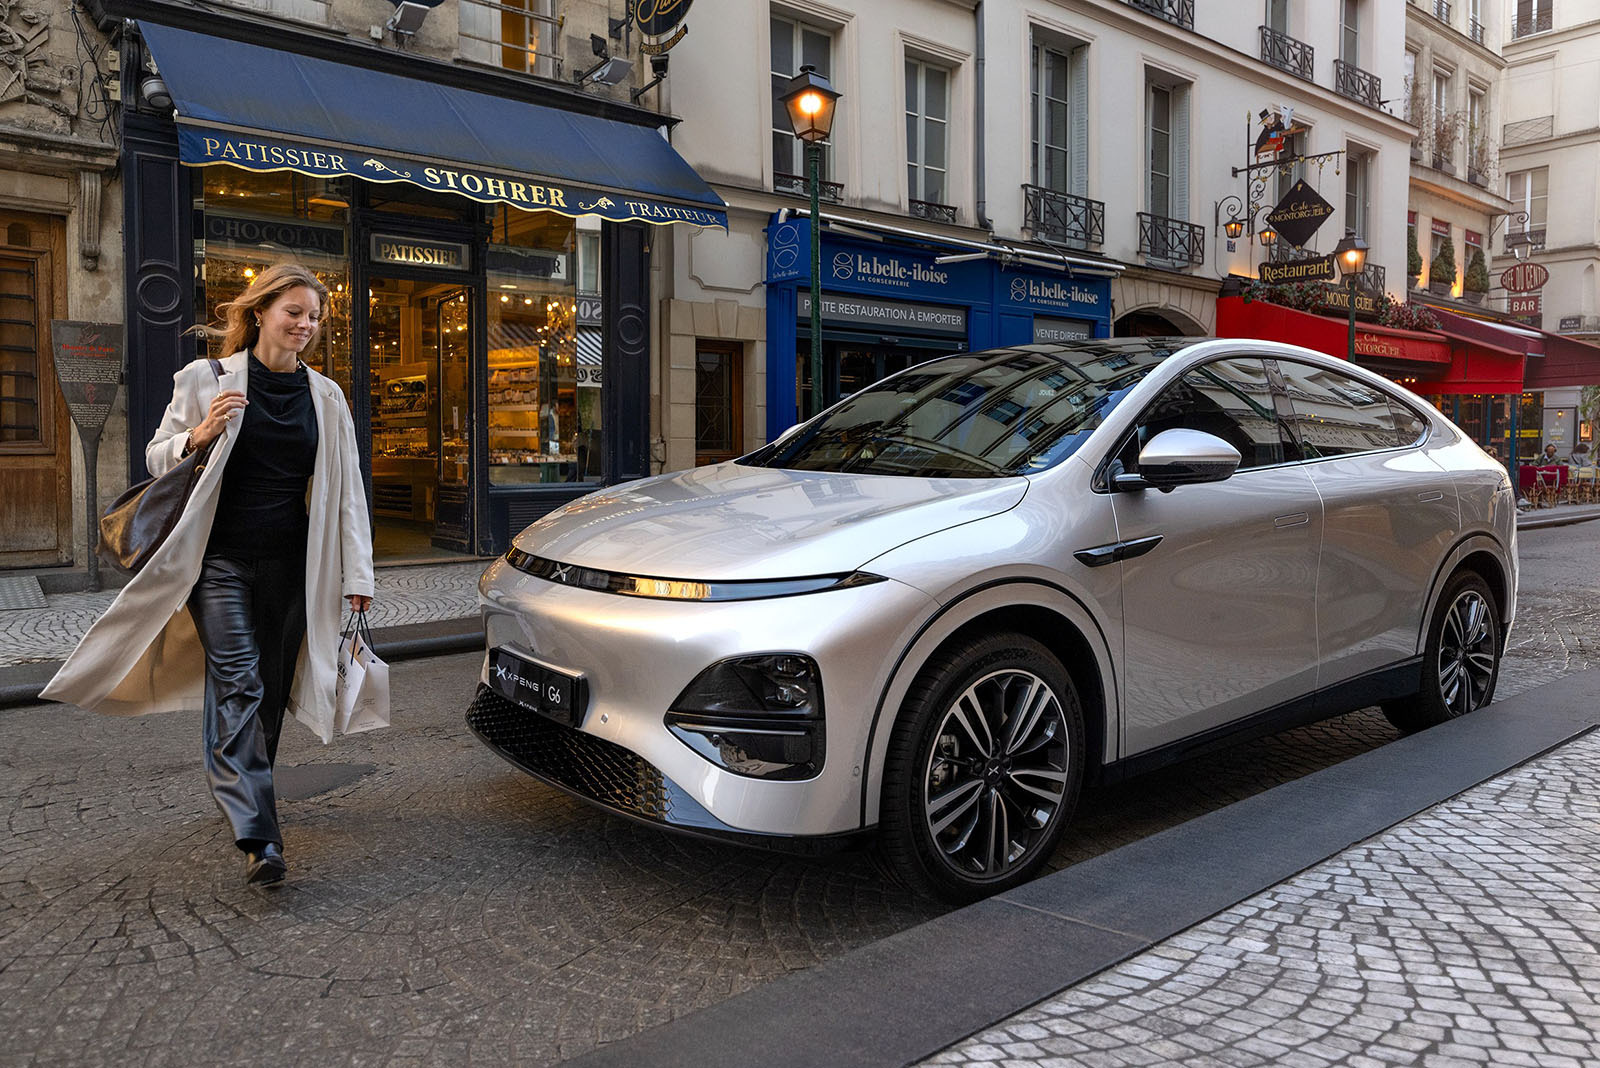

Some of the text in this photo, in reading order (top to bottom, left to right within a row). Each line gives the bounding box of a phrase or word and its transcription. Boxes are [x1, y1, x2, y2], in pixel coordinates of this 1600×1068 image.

[203, 137, 720, 224] PATISSIER STOHRER TRAITEUR
[380, 243, 458, 265] PATISSIER
[1264, 259, 1330, 282] Restaurant
[1326, 291, 1374, 311] MONTOGUEIL
[1513, 301, 1535, 311] BAR
[838, 303, 907, 320] RESTAURATION
[917, 311, 962, 326] EMPORTER
[1036, 329, 1059, 339] VENTE
[507, 672, 561, 704] XPENG G6
